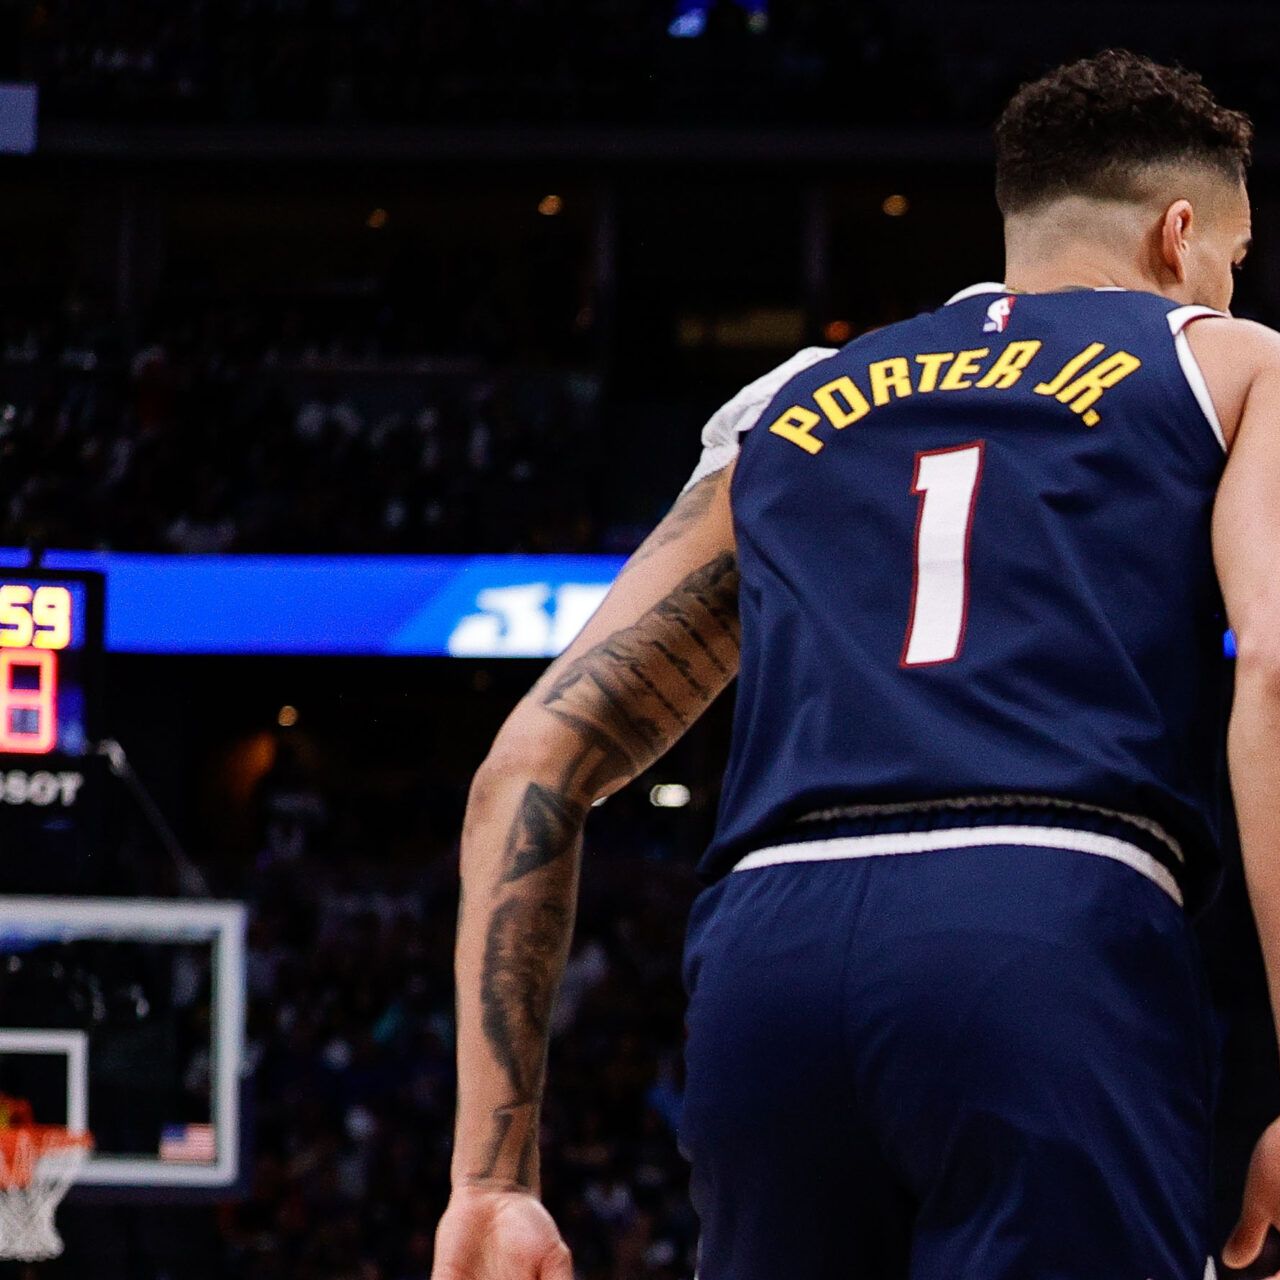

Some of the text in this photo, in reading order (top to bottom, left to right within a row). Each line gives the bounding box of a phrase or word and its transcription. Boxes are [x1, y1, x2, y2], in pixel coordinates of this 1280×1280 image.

[769, 339, 1142, 455] PORTER JR.
[900, 438, 985, 669] 1
[0, 584, 72, 650] 59
